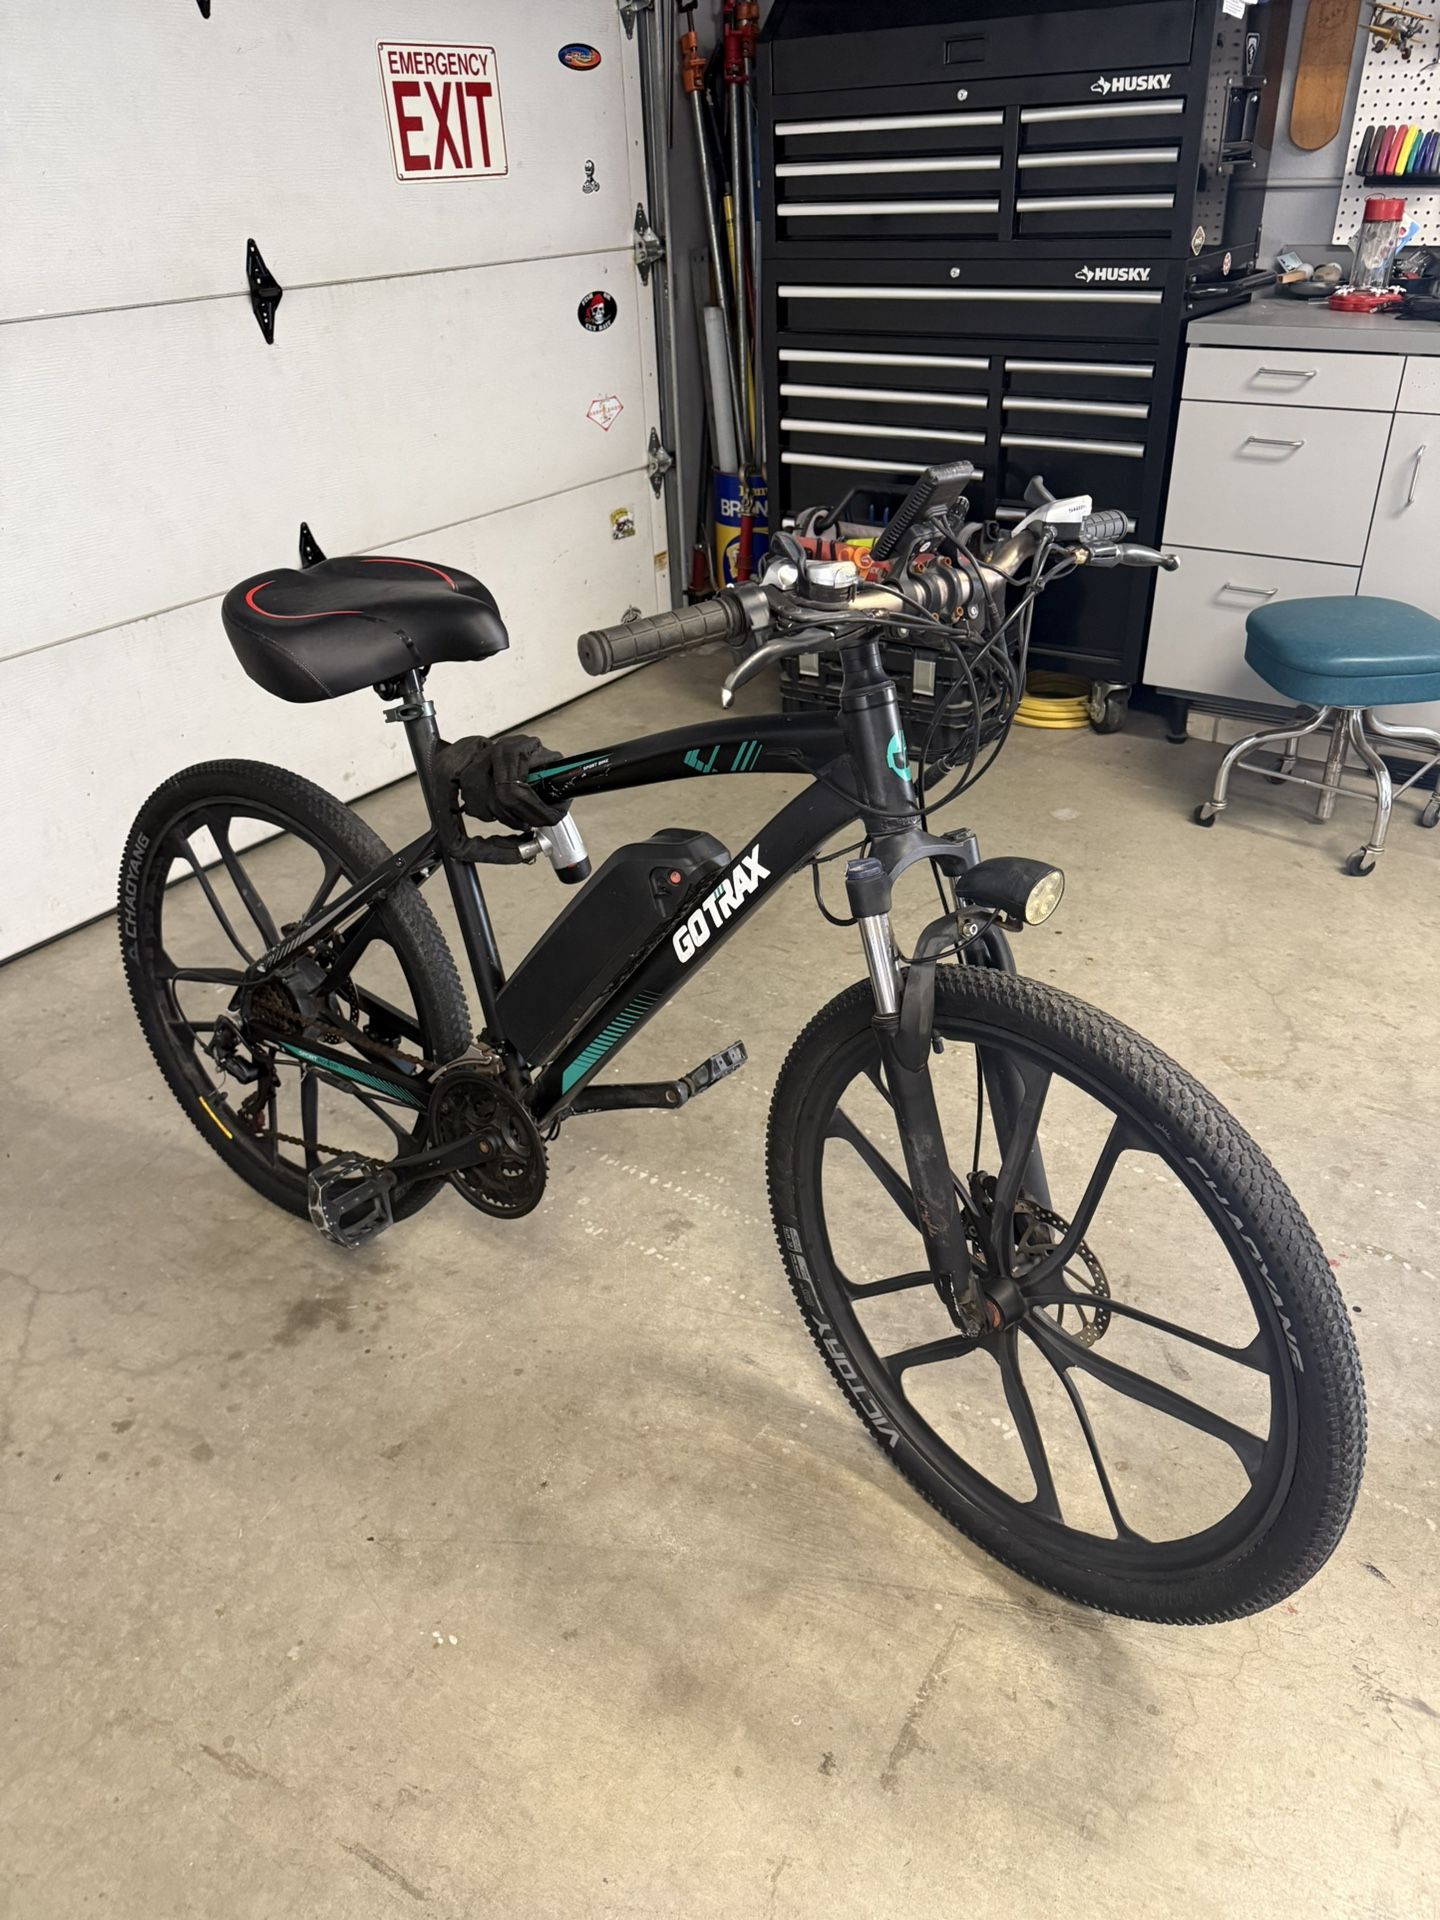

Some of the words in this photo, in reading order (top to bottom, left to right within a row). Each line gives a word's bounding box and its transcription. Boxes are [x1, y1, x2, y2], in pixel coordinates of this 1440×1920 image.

[388, 51, 488, 76] EMERGENCY
[1111, 74, 1171, 93] HUSKY
[392, 81, 493, 171] EXIT
[1094, 267, 1150, 282] HUSKY
[124, 831, 150, 939] CHAOYANG
[1186, 1156, 1304, 1373] CHAOYANG
[811, 1313, 900, 1449] VICTORY
